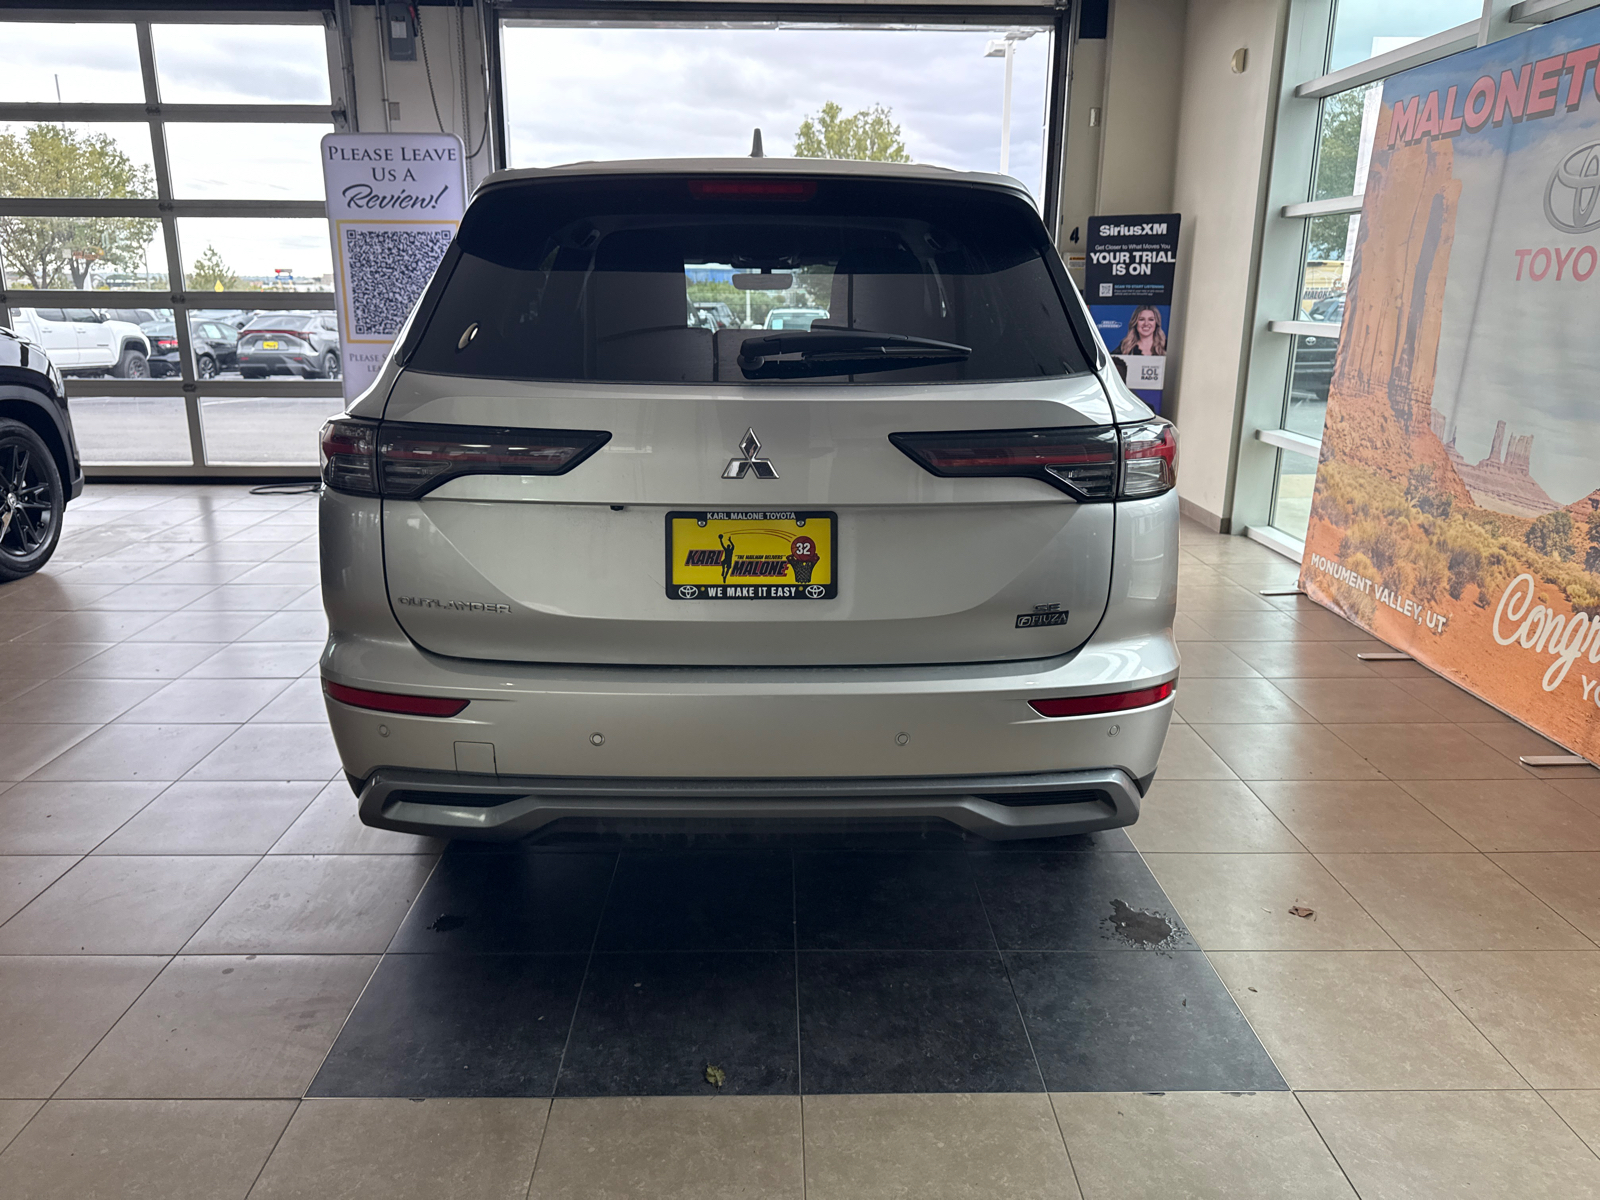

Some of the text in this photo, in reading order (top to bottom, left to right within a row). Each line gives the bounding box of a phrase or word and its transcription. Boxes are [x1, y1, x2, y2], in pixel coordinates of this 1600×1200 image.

[1387, 43, 1600, 150] MALONET
[328, 146, 457, 162] PLEASE LEAVE
[402, 167, 417, 182] A
[342, 183, 449, 209] Review!
[1069, 226, 1080, 245] 4
[1099, 223, 1167, 237] SiriusXM
[1090, 251, 1130, 264] YOUR
[1132, 251, 1176, 263] TRIAL
[1112, 263, 1151, 275] IS ON
[349, 352, 379, 362] PLEASE
[1141, 368, 1158, 376] LOL
[707, 512, 796, 520] KARL MALONE TOYOTA
[796, 542, 811, 555] 32
[685, 549, 724, 566] KARL
[730, 560, 788, 577] MALONE
[708, 587, 796, 597] WE MAKE IT EASY
[1311, 552, 1447, 633] MONUMENT VALLEY, UT
[398, 596, 512, 614] OUTLANDER
